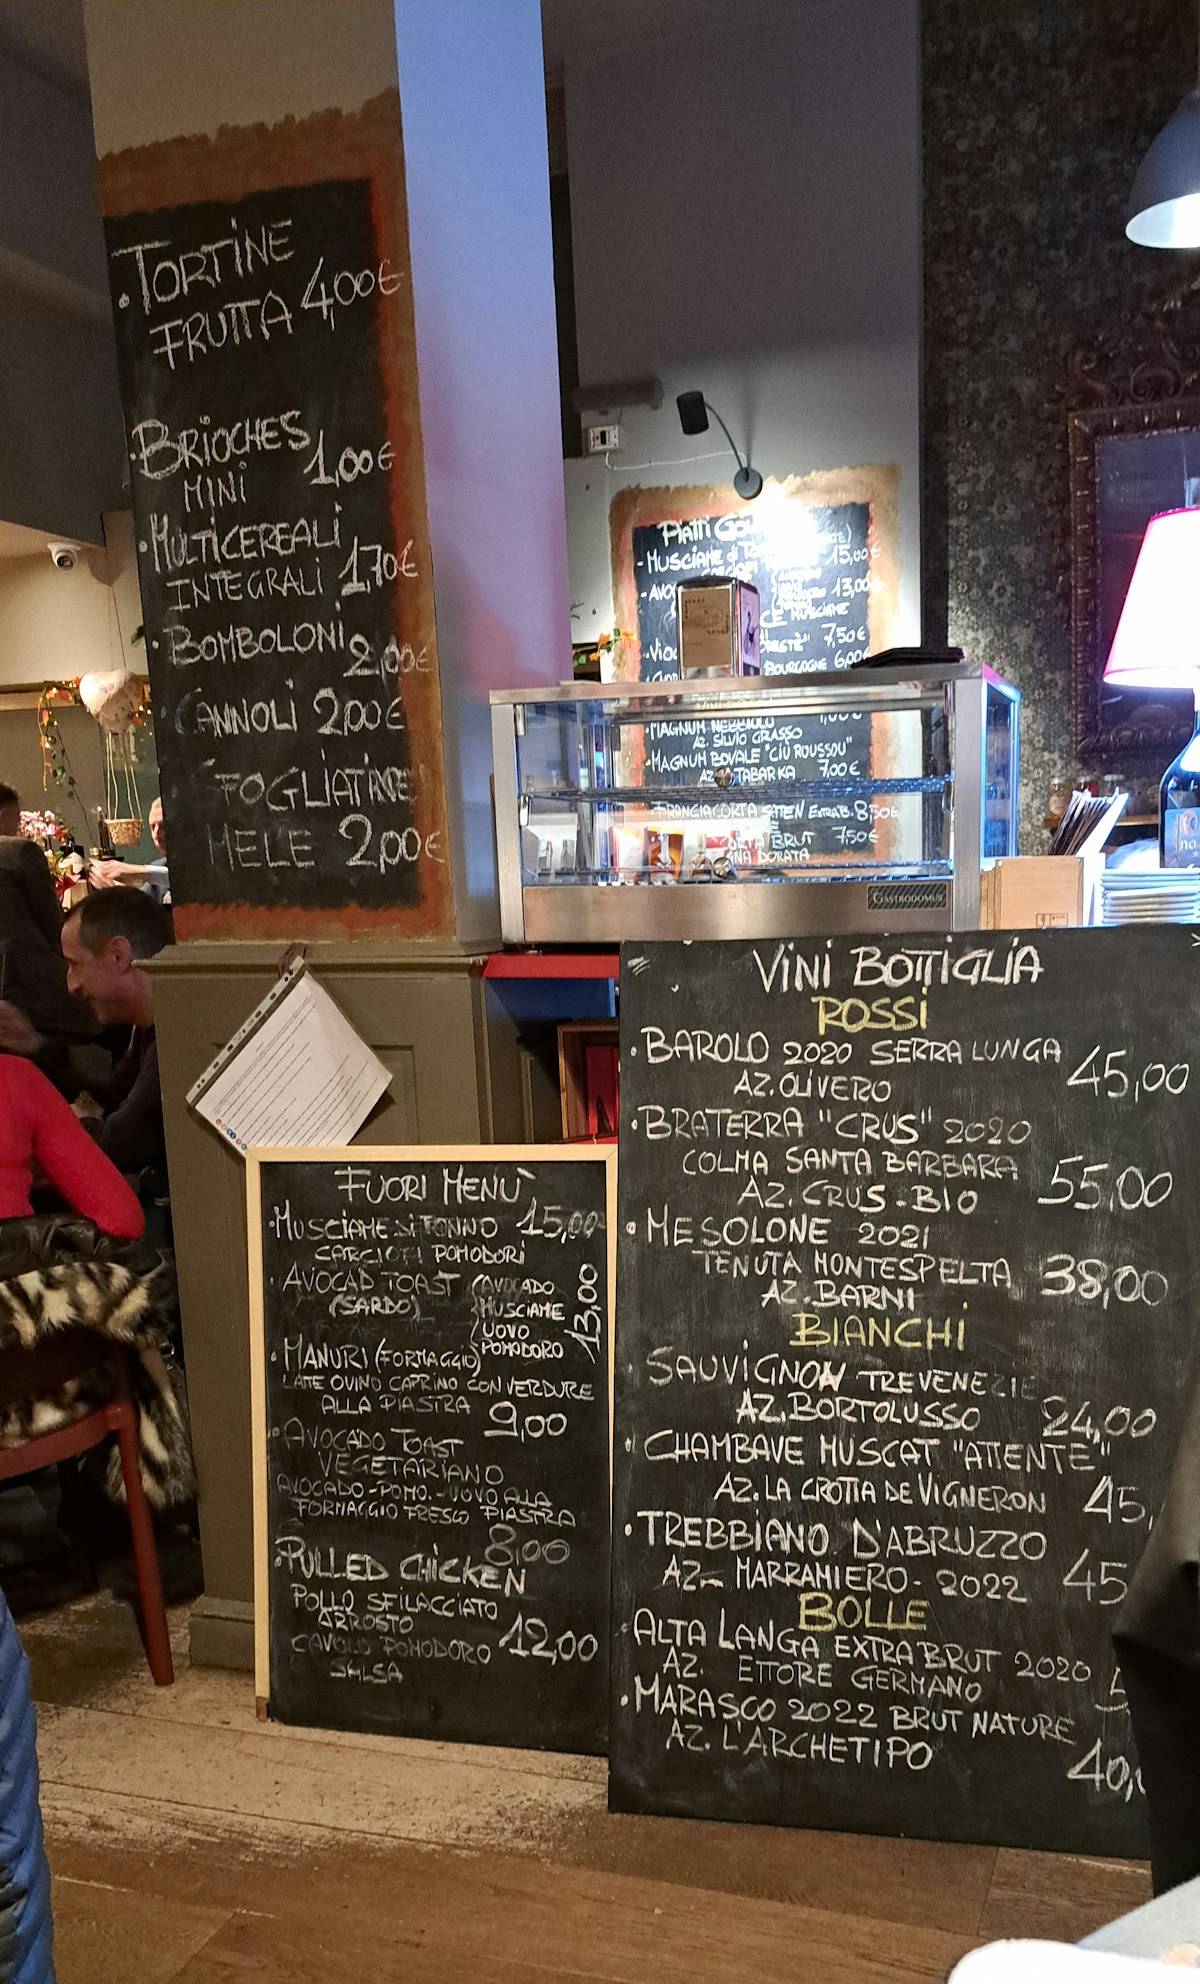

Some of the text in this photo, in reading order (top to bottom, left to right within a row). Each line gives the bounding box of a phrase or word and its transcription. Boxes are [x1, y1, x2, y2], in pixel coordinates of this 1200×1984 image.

[111, 217, 295, 316] TORTINE
[150, 291, 294, 370] FRUTTA
[131, 410, 311, 481] BRIOCHES
[184, 461, 247, 513] MINI
[150, 502, 342, 573] MULTICEREALI
[166, 557, 324, 611] INTEGRALI
[163, 600, 345, 668] BOMBOLONI
[651, 747, 708, 774] MAGNUM
[710, 746, 762, 767] BOVALE
[752, 935, 1045, 993] VINI BOTTIGLIA
[811, 987, 928, 1035] ROSSI
[641, 1026, 769, 1065] BAROLO
[783, 1042, 853, 1066] 2020
[1066, 1044, 1189, 1102] 45,00
[637, 1106, 804, 1140] BRATERRA
[942, 1118, 1032, 1144] 2020
[334, 1166, 426, 1204] FUORI
[682, 1147, 1173, 1212] COLMA SANTA BARBARA 55,00
[274, 1200, 389, 1240] MUSCIAME
[646, 1204, 929, 1249] MESOLONE 2021
[431, 1240, 525, 1265] POMODORI
[381, 1270, 460, 1297] TOAST
[691, 1249, 802, 1279] TENUTA
[1041, 1254, 1168, 1310] 38,00
[479, 1296, 566, 1321] MUSCIAME
[482, 1321, 530, 1340] UOVO
[789, 1301, 967, 1352] BIANCHI
[284, 1334, 368, 1371] MANURI
[481, 1338, 564, 1360] POMODORO
[647, 1340, 846, 1393] SAUVIGNON
[330, 1374, 382, 1392] OVINO
[467, 1375, 502, 1396] CON
[507, 1376, 595, 1401] VERDURE
[284, 1417, 464, 1458] AVOCADO TOAST
[321, 1395, 568, 1443] ALLA PIASTRA 9,00
[1040, 1396, 1156, 1444] 24,00
[318, 1451, 505, 1486] VEGETARIANO
[644, 1430, 804, 1466] CHAMBAVE
[820, 1437, 940, 1469] MUSCAT
[297, 1499, 398, 1520] FORMAGGIO
[480, 1504, 577, 1527] PIASTRA
[504, 1487, 553, 1507] ALLA
[885, 1480, 911, 1503] DE
[917, 1474, 1047, 1514] VIGNERON
[637, 1511, 830, 1556] TREBBIANO
[275, 1535, 526, 1597] PULLED CHICKEN
[936, 1570, 1028, 1603] 2022
[290, 1583, 498, 1620] POLLO SFILACCIATO
[798, 1591, 929, 1633] BOLLE
[318, 1611, 599, 1666] ARROSTO 12,00
[379, 1635, 492, 1665] POMODORO
[633, 1607, 708, 1648] ALTA
[718, 1607, 819, 1658] LANGA
[917, 1642, 1002, 1676] BRUT
[1014, 1651, 1092, 1683] 2020
[738, 1655, 833, 1689] ETTORE
[851, 1665, 982, 1702] GERMANO
[636, 1674, 1078, 1746] MARASCO 2022 BRUT NATURE
